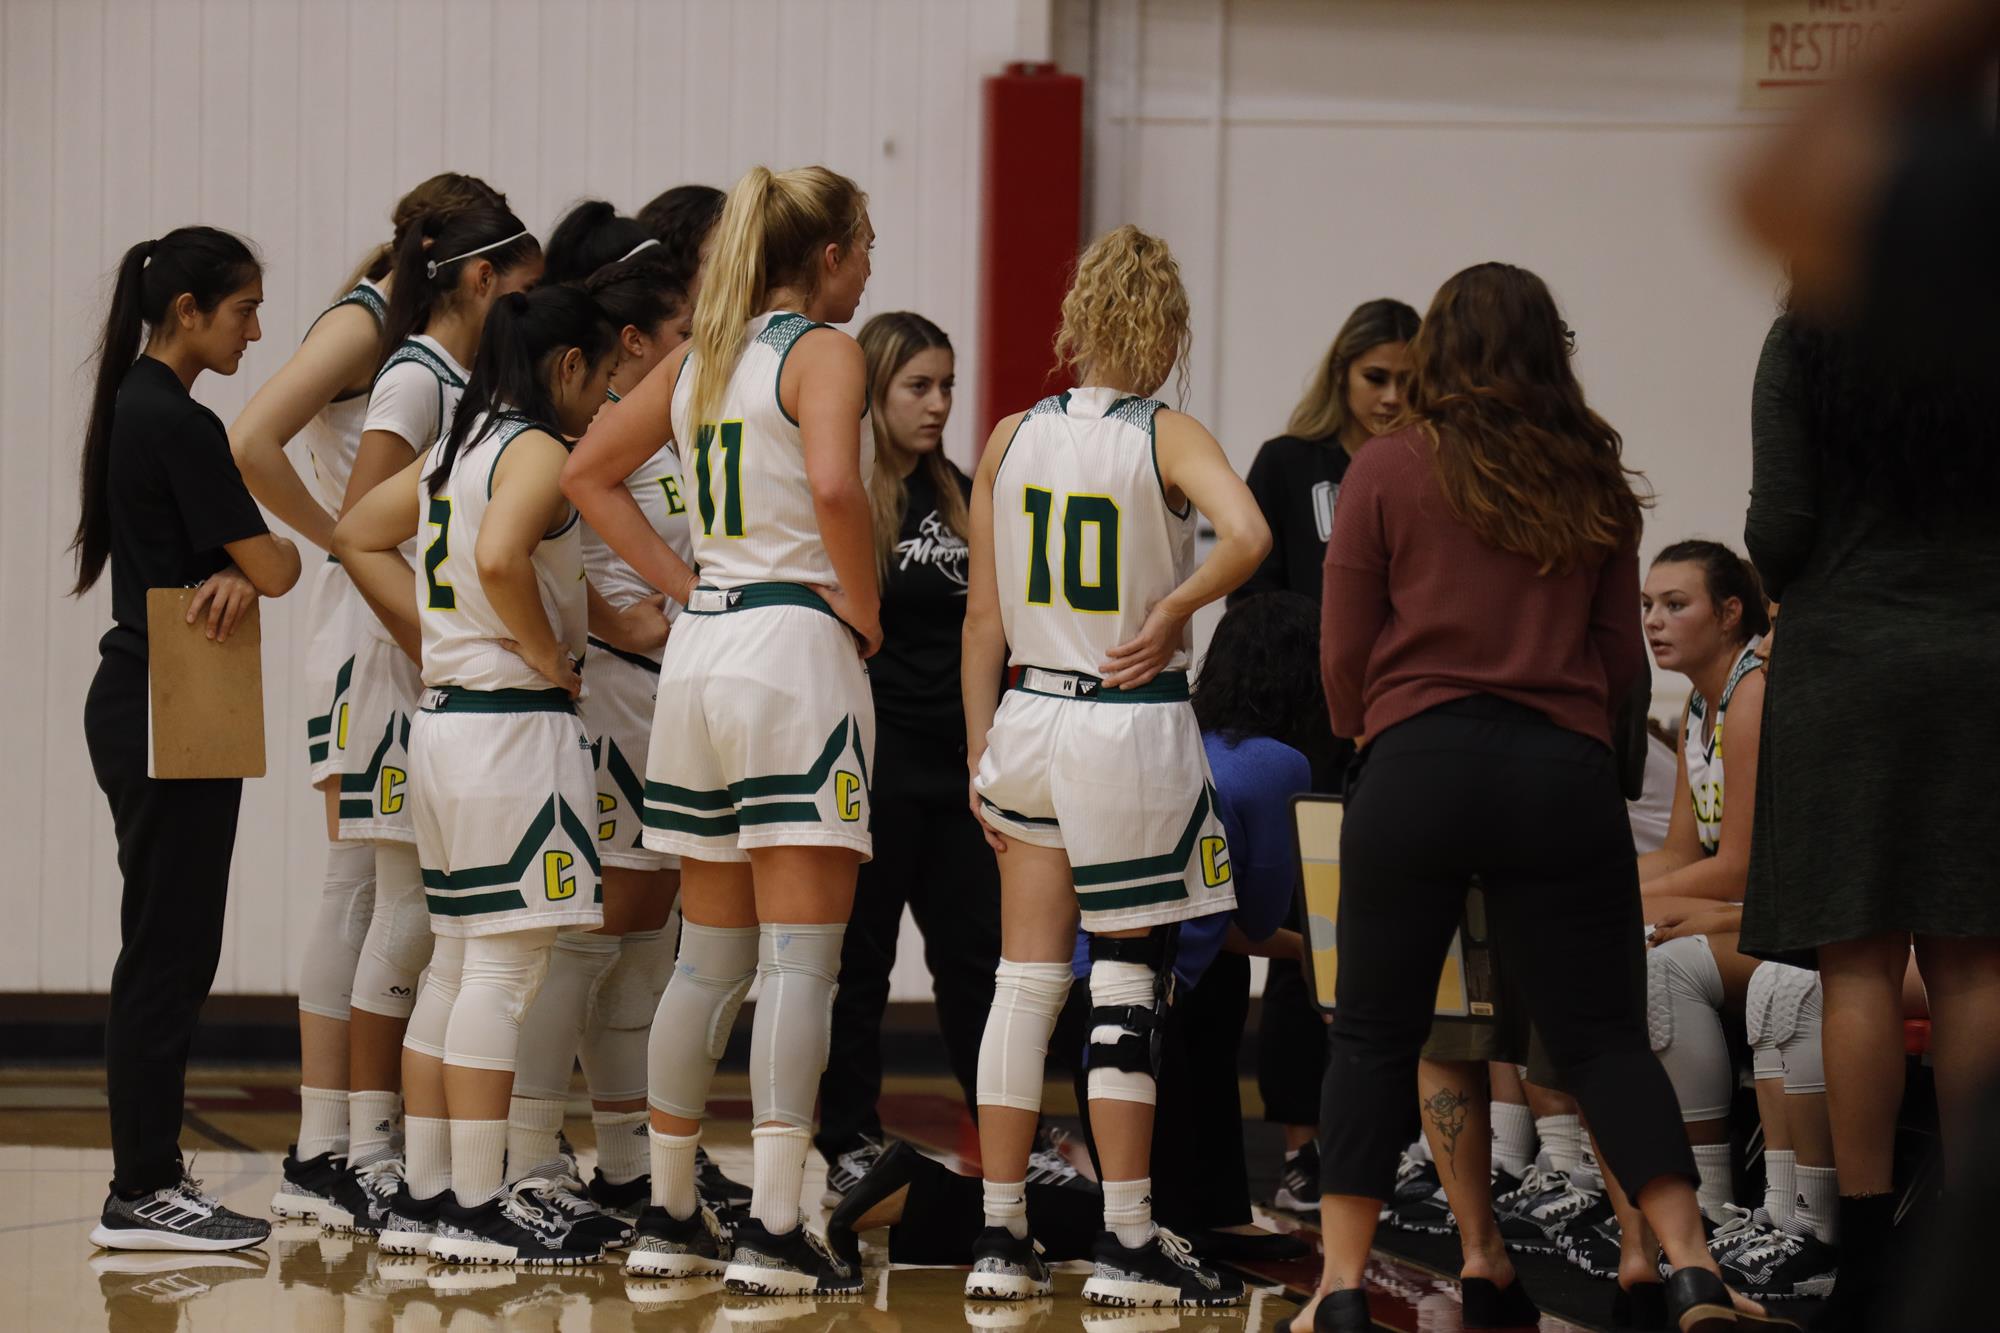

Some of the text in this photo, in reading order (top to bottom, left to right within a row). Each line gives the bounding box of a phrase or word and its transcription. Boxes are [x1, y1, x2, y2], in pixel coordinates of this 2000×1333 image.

[693, 418, 745, 538] 11
[424, 496, 457, 612] 2
[1023, 484, 1121, 615] 10
[380, 765, 407, 815] C
[834, 769, 861, 822] C
[543, 850, 576, 901] C
[1199, 835, 1231, 888] C
